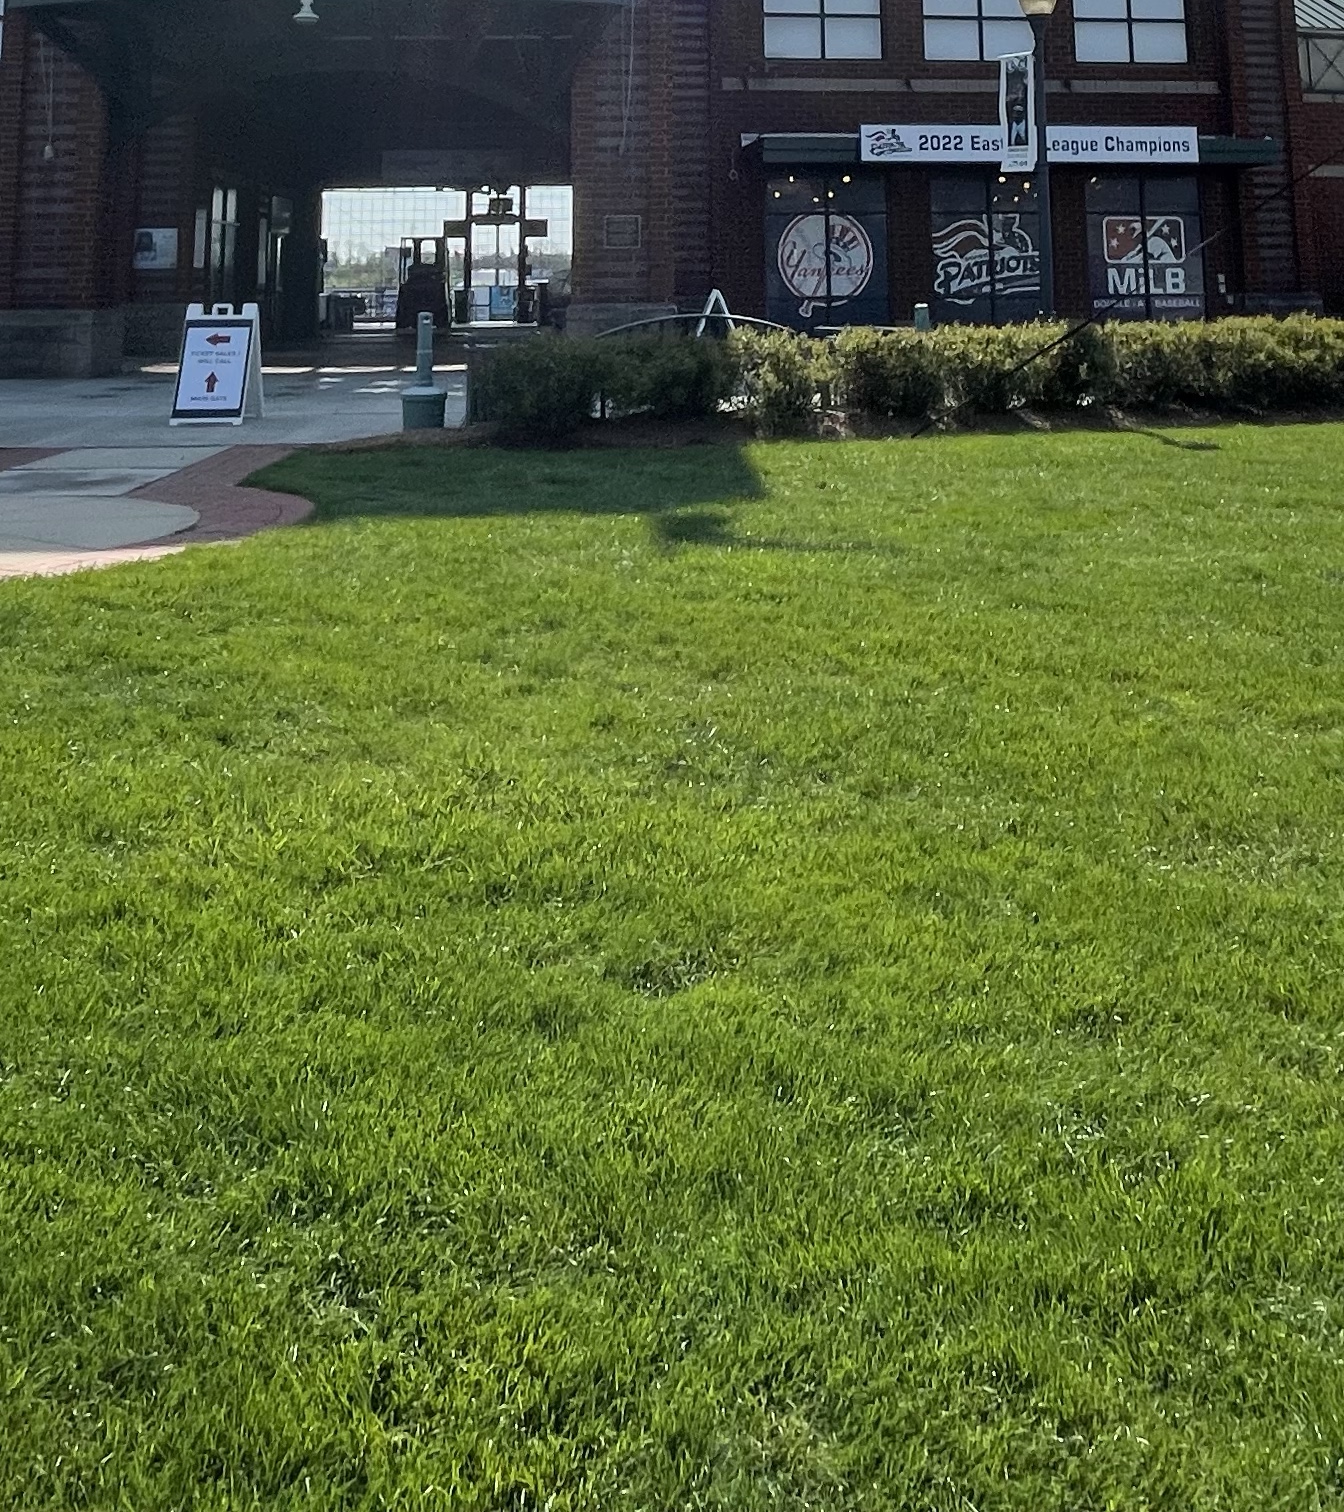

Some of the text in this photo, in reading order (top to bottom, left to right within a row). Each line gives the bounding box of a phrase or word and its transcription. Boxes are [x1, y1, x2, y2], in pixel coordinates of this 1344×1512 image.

[918, 135, 964, 151] 2022
[1104, 135, 1191, 155] Champions
[783, 240, 867, 280] Yanees
[936, 255, 1040, 294] PATIOTS
[1107, 267, 1186, 295] MiLB
